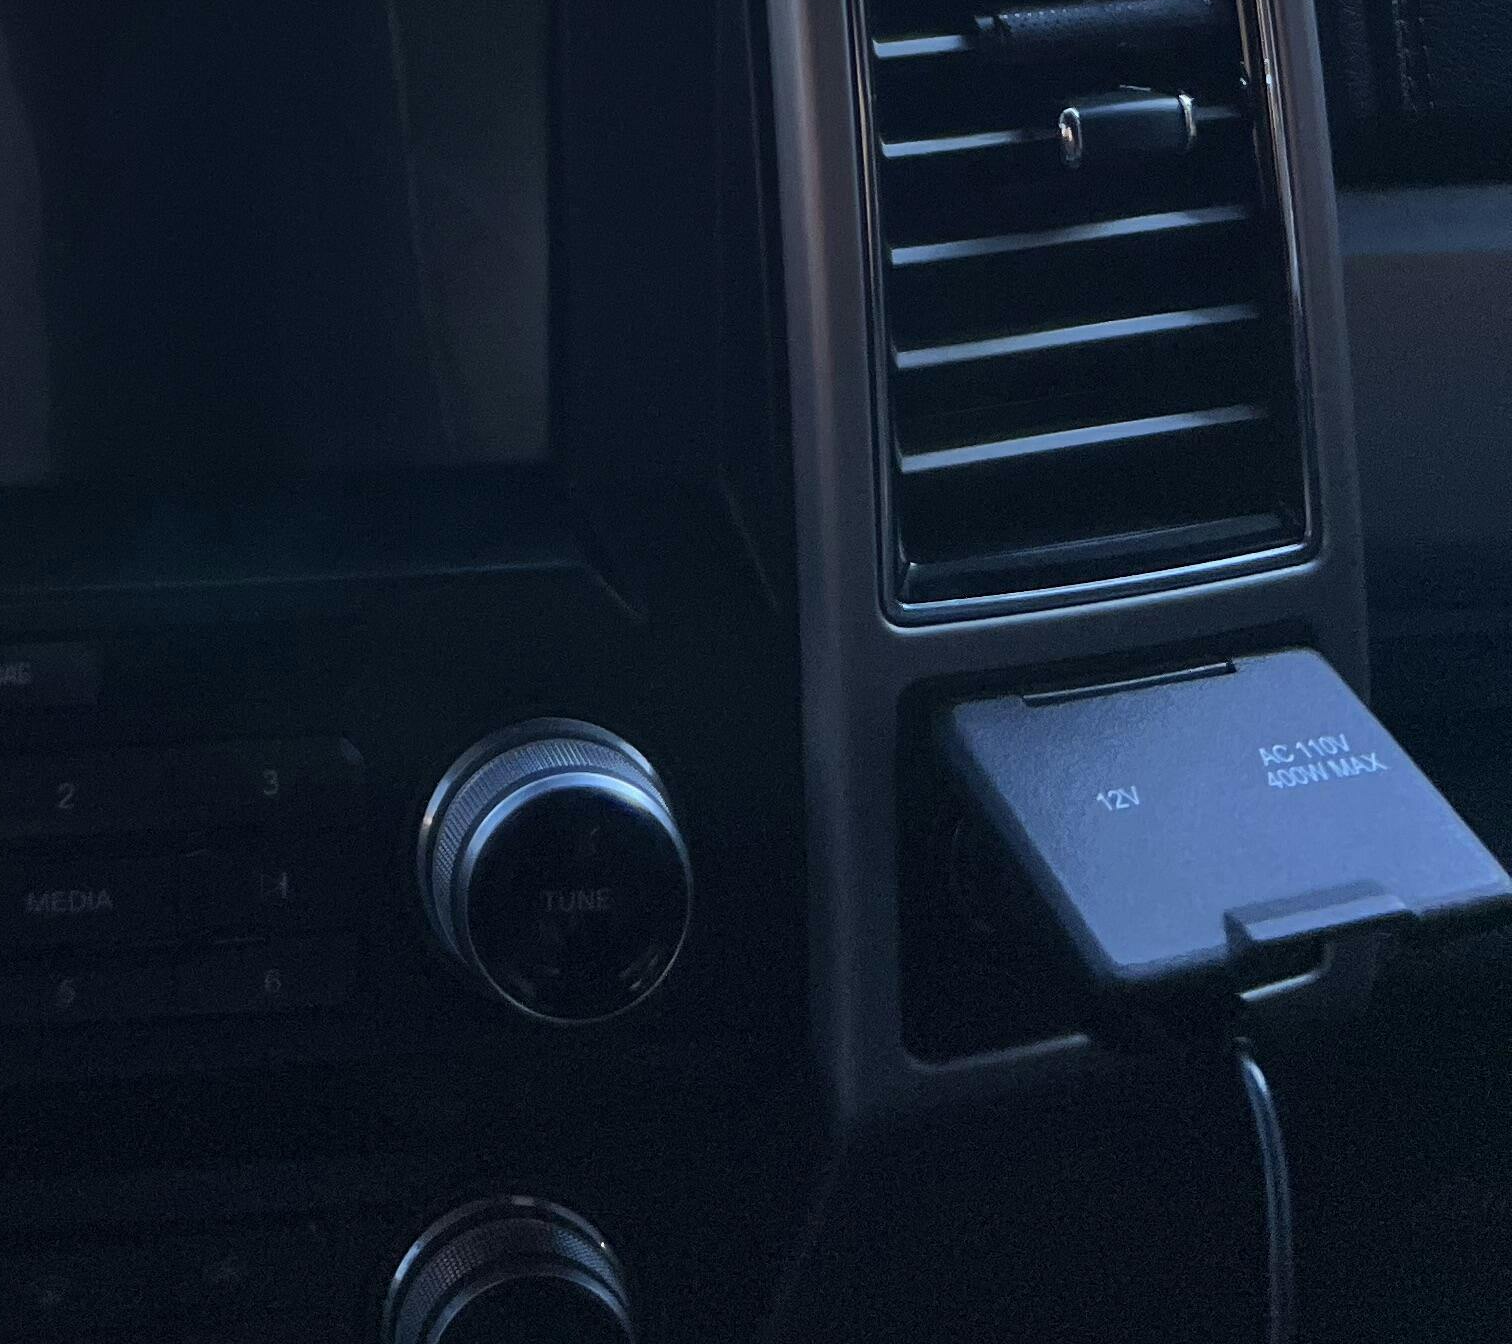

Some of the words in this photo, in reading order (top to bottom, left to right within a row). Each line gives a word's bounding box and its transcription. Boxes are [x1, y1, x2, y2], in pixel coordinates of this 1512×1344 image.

[1257, 743, 1296, 767] AC
[1294, 730, 1351, 759] 110V
[261, 769, 279, 796] 3
[1267, 759, 1330, 789] 400W
[1324, 748, 1388, 778] MAX
[57, 781, 75, 810] 2
[1096, 785, 1141, 811] 12V
[26, 888, 115, 915] MEDIA
[540, 886, 611, 914] TUNE
[56, 978, 76, 1010] 5
[263, 968, 282, 995] 6
